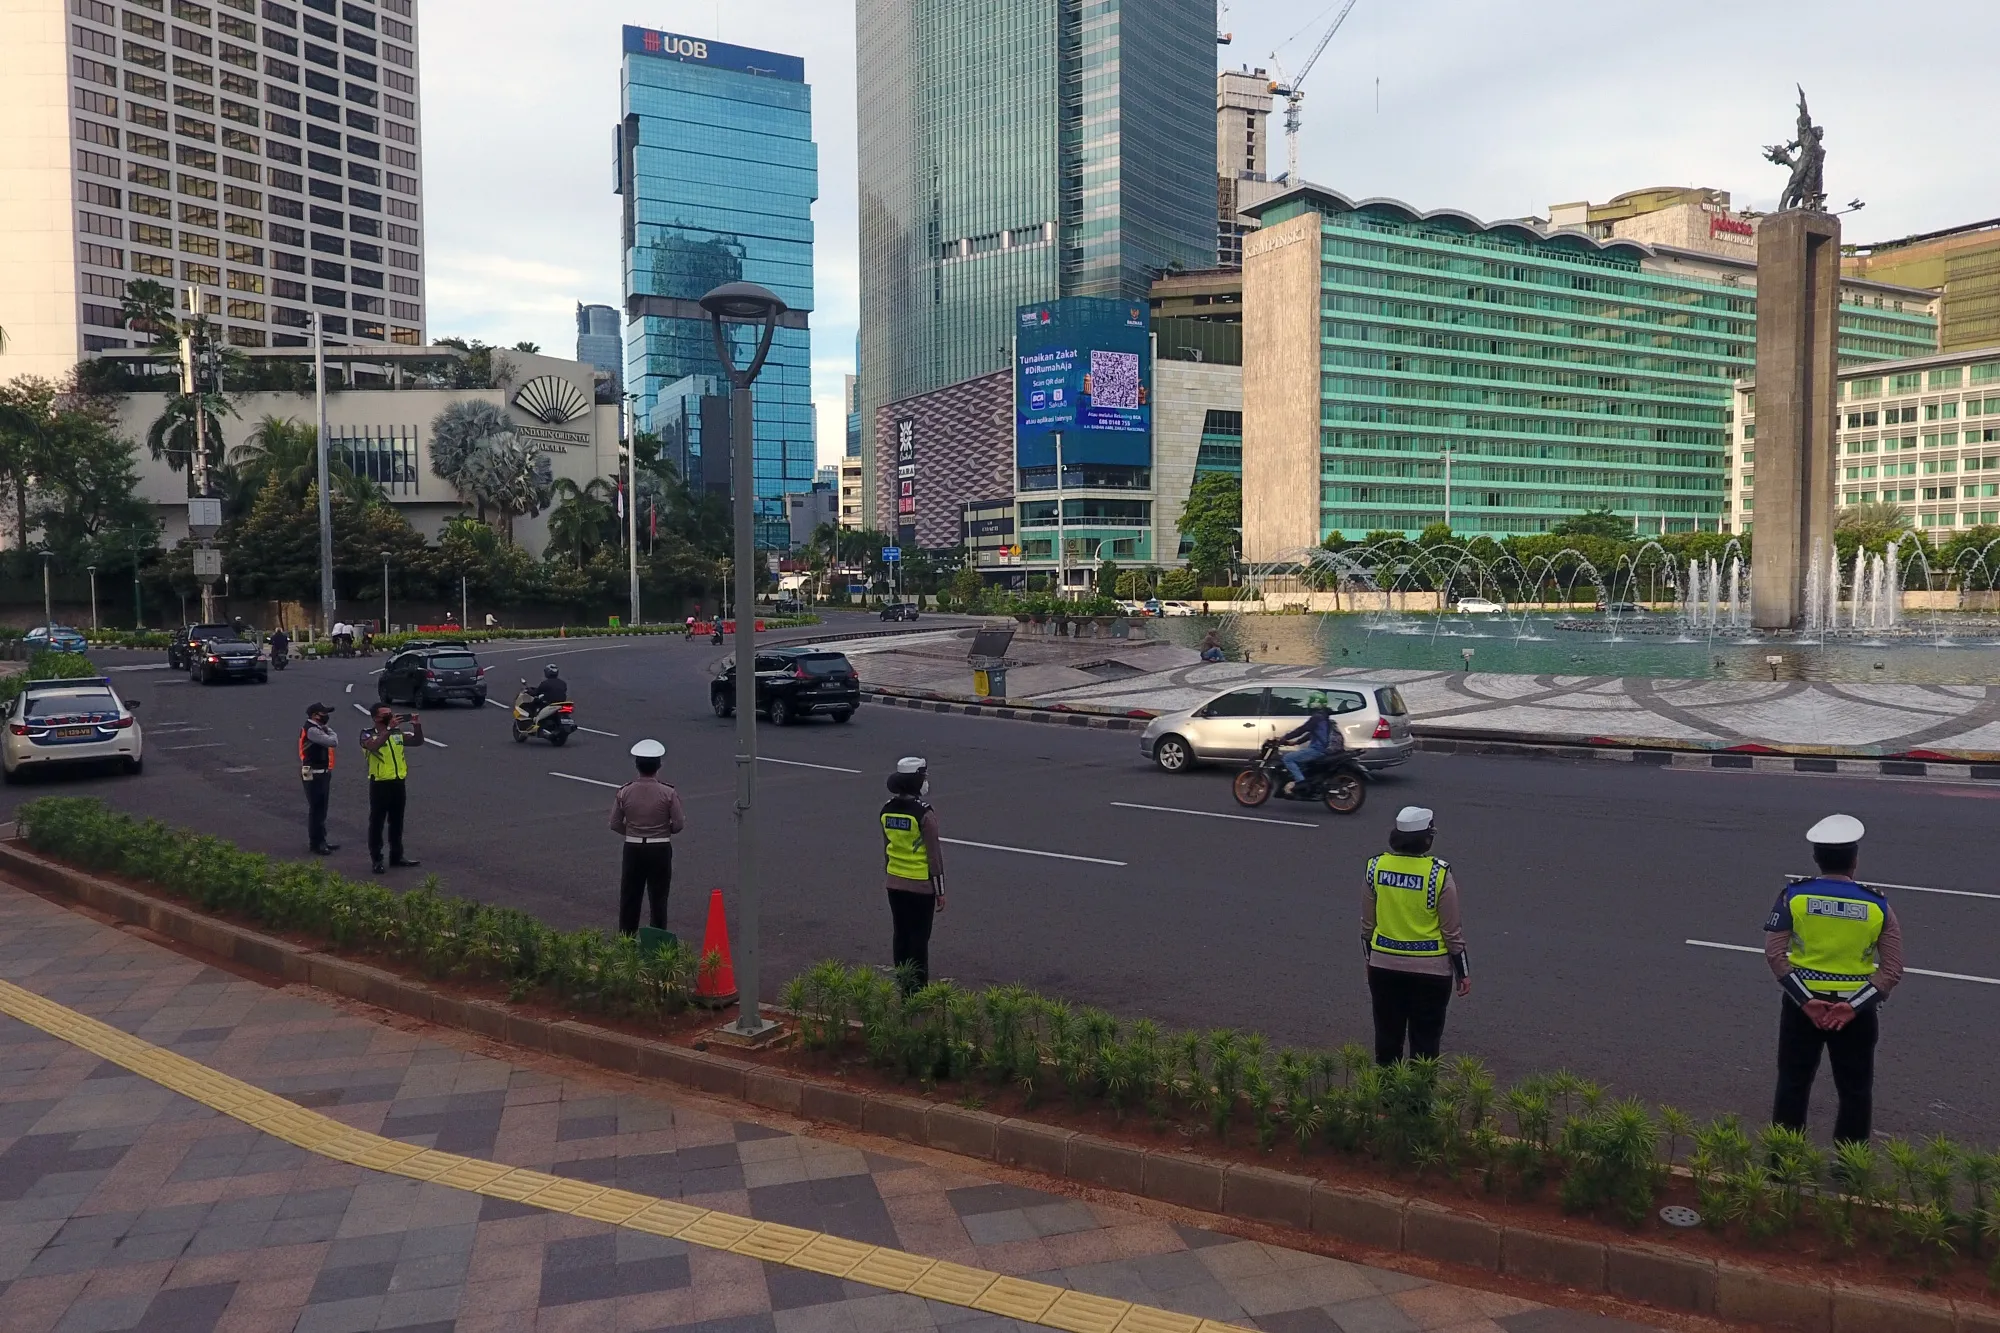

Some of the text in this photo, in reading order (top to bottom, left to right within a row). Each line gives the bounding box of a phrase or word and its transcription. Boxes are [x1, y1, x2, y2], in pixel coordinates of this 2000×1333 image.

[664, 36, 707, 59] UOB
[1245, 226, 1306, 259] KEMPINSKI
[1020, 349, 1078, 365] Tunaikan Zakat
[1025, 362, 1072, 375] #DiRumahAja
[518, 427, 554, 439] ANDARIN
[537, 442, 568, 453] JAKARTA
[886, 817, 910, 830] POLISI
[1378, 871, 1422, 889] POLISI
[1808, 898, 1867, 919] POLISI
